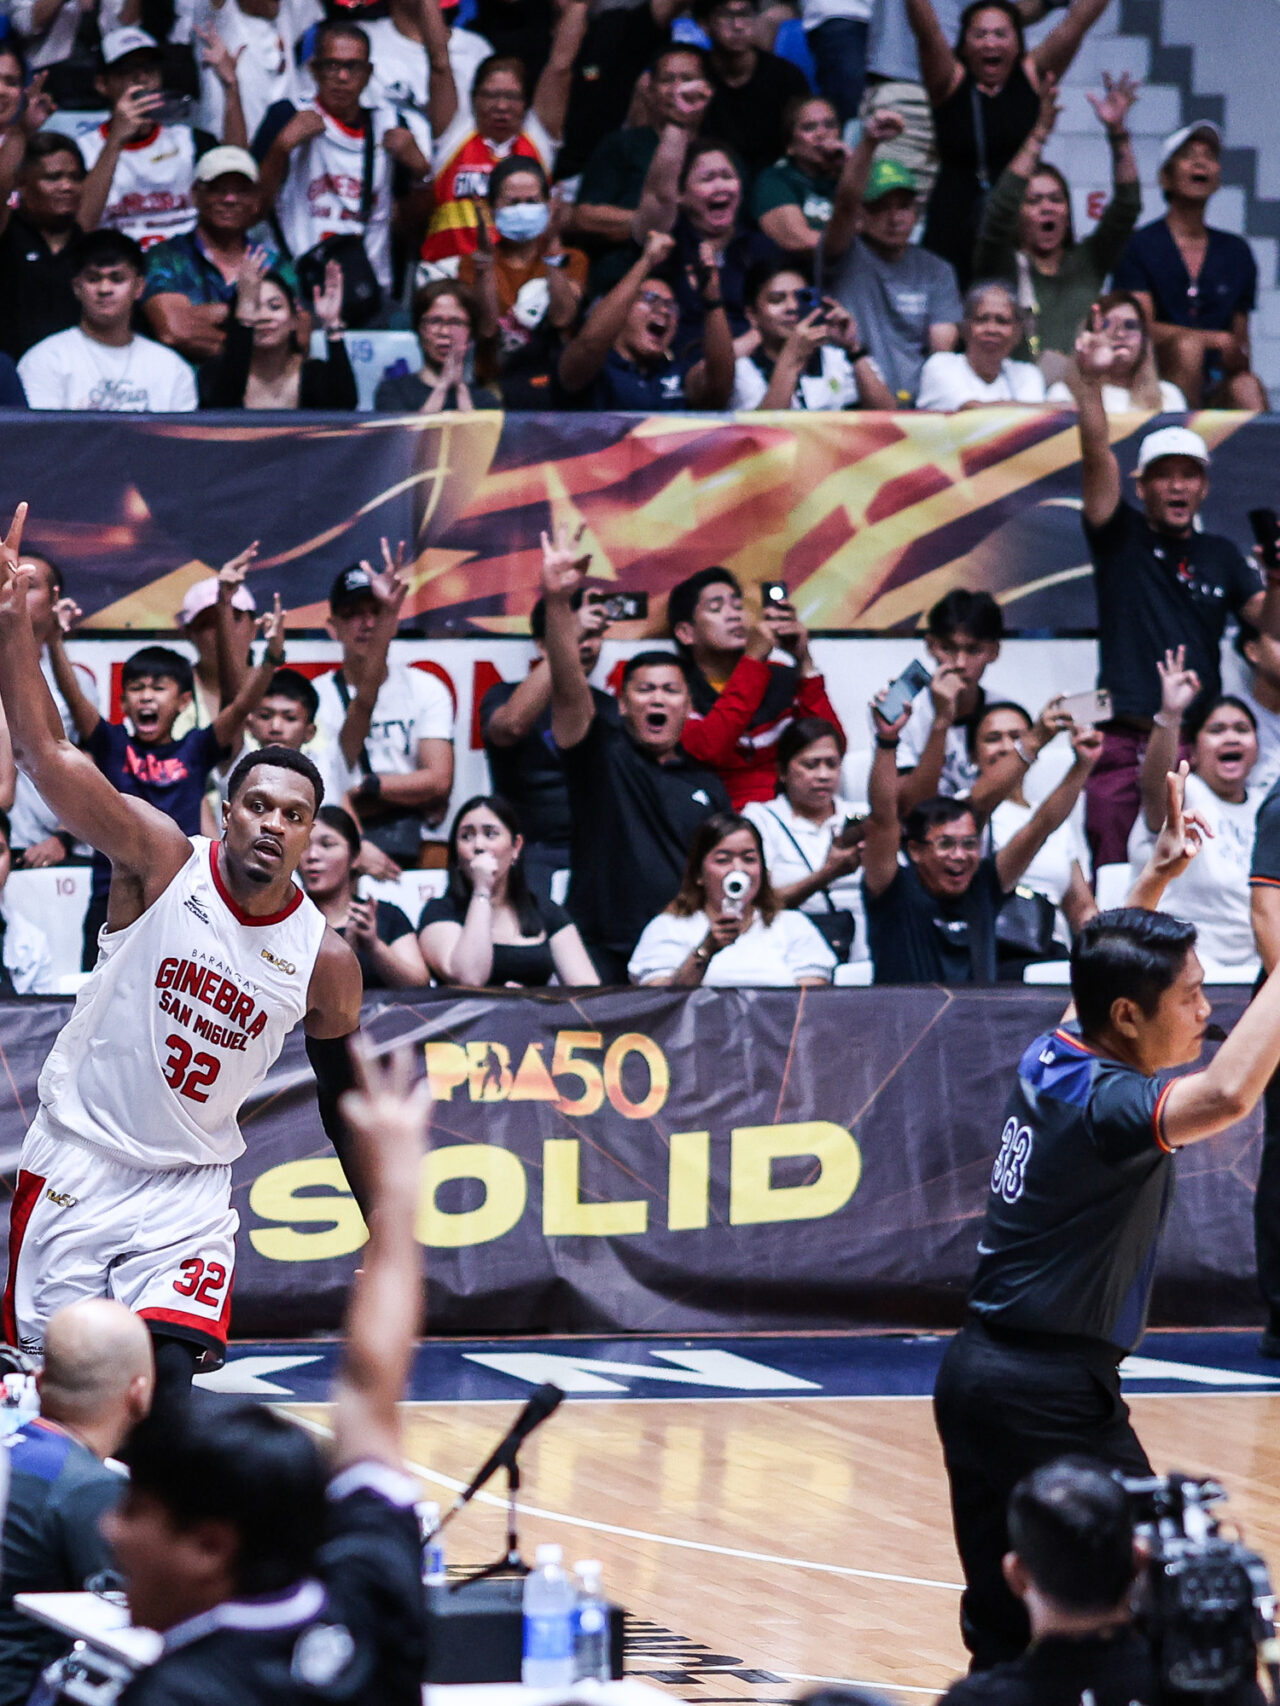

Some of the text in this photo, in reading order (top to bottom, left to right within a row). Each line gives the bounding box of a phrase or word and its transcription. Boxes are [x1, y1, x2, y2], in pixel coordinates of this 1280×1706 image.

[56, 878, 76, 896] 10
[155, 957, 268, 1040] GINEBRA
[192, 948, 260, 993] BARANGAY
[158, 989, 250, 1052] SAN MIGUEL
[161, 1034, 221, 1104] 32
[249, 1120, 862, 1262] SOLID
[991, 1116, 1034, 1204] 33
[173, 1258, 226, 1307] 32
